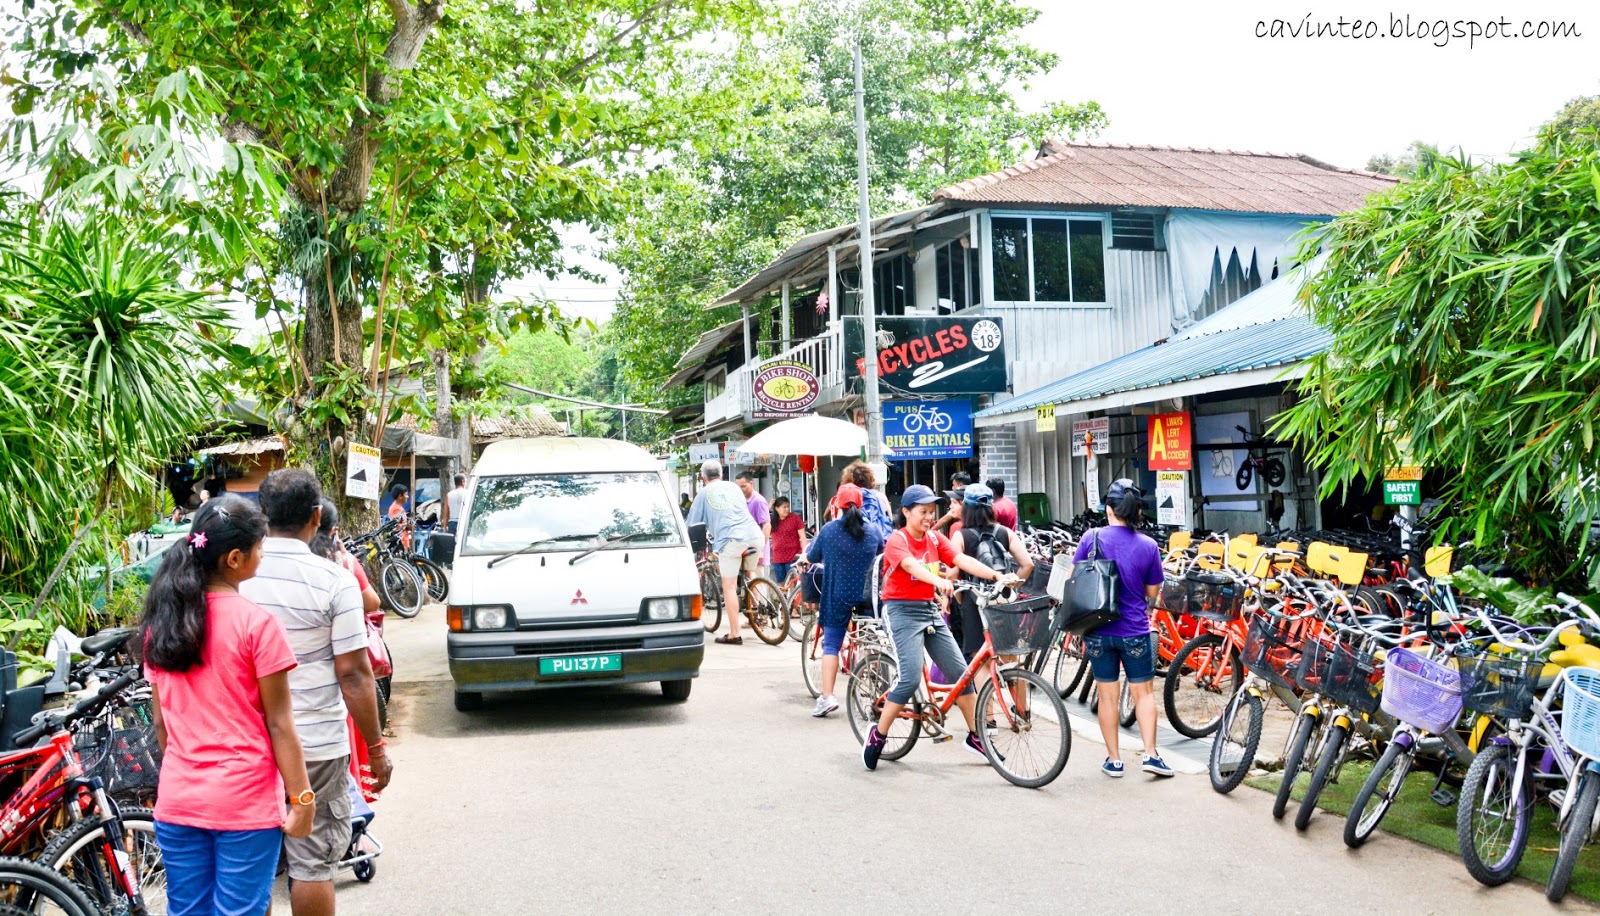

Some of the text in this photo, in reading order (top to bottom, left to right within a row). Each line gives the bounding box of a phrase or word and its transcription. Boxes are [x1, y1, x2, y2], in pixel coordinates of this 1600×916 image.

[973, 321, 1000, 340] PULAU UBIN
[981, 335, 994, 348] 18
[761, 368, 813, 383] BIKE SHOP
[797, 385, 807, 393] 18
[757, 391, 816, 408] BICYCLE RENTALS
[895, 405, 918, 414] PU18
[1166, 417, 1183, 426] LWAYS
[1167, 428, 1180, 437] LERT
[886, 433, 971, 448] BIKE RENTALS
[1150, 418, 1167, 461] A
[1167, 439, 1180, 448] VOID
[356, 446, 379, 457] CAUTION
[1167, 450, 1189, 460] CCIDENT
[1386, 483, 1416, 492] SAFETY
[1391, 493, 1413, 503] FIRST
